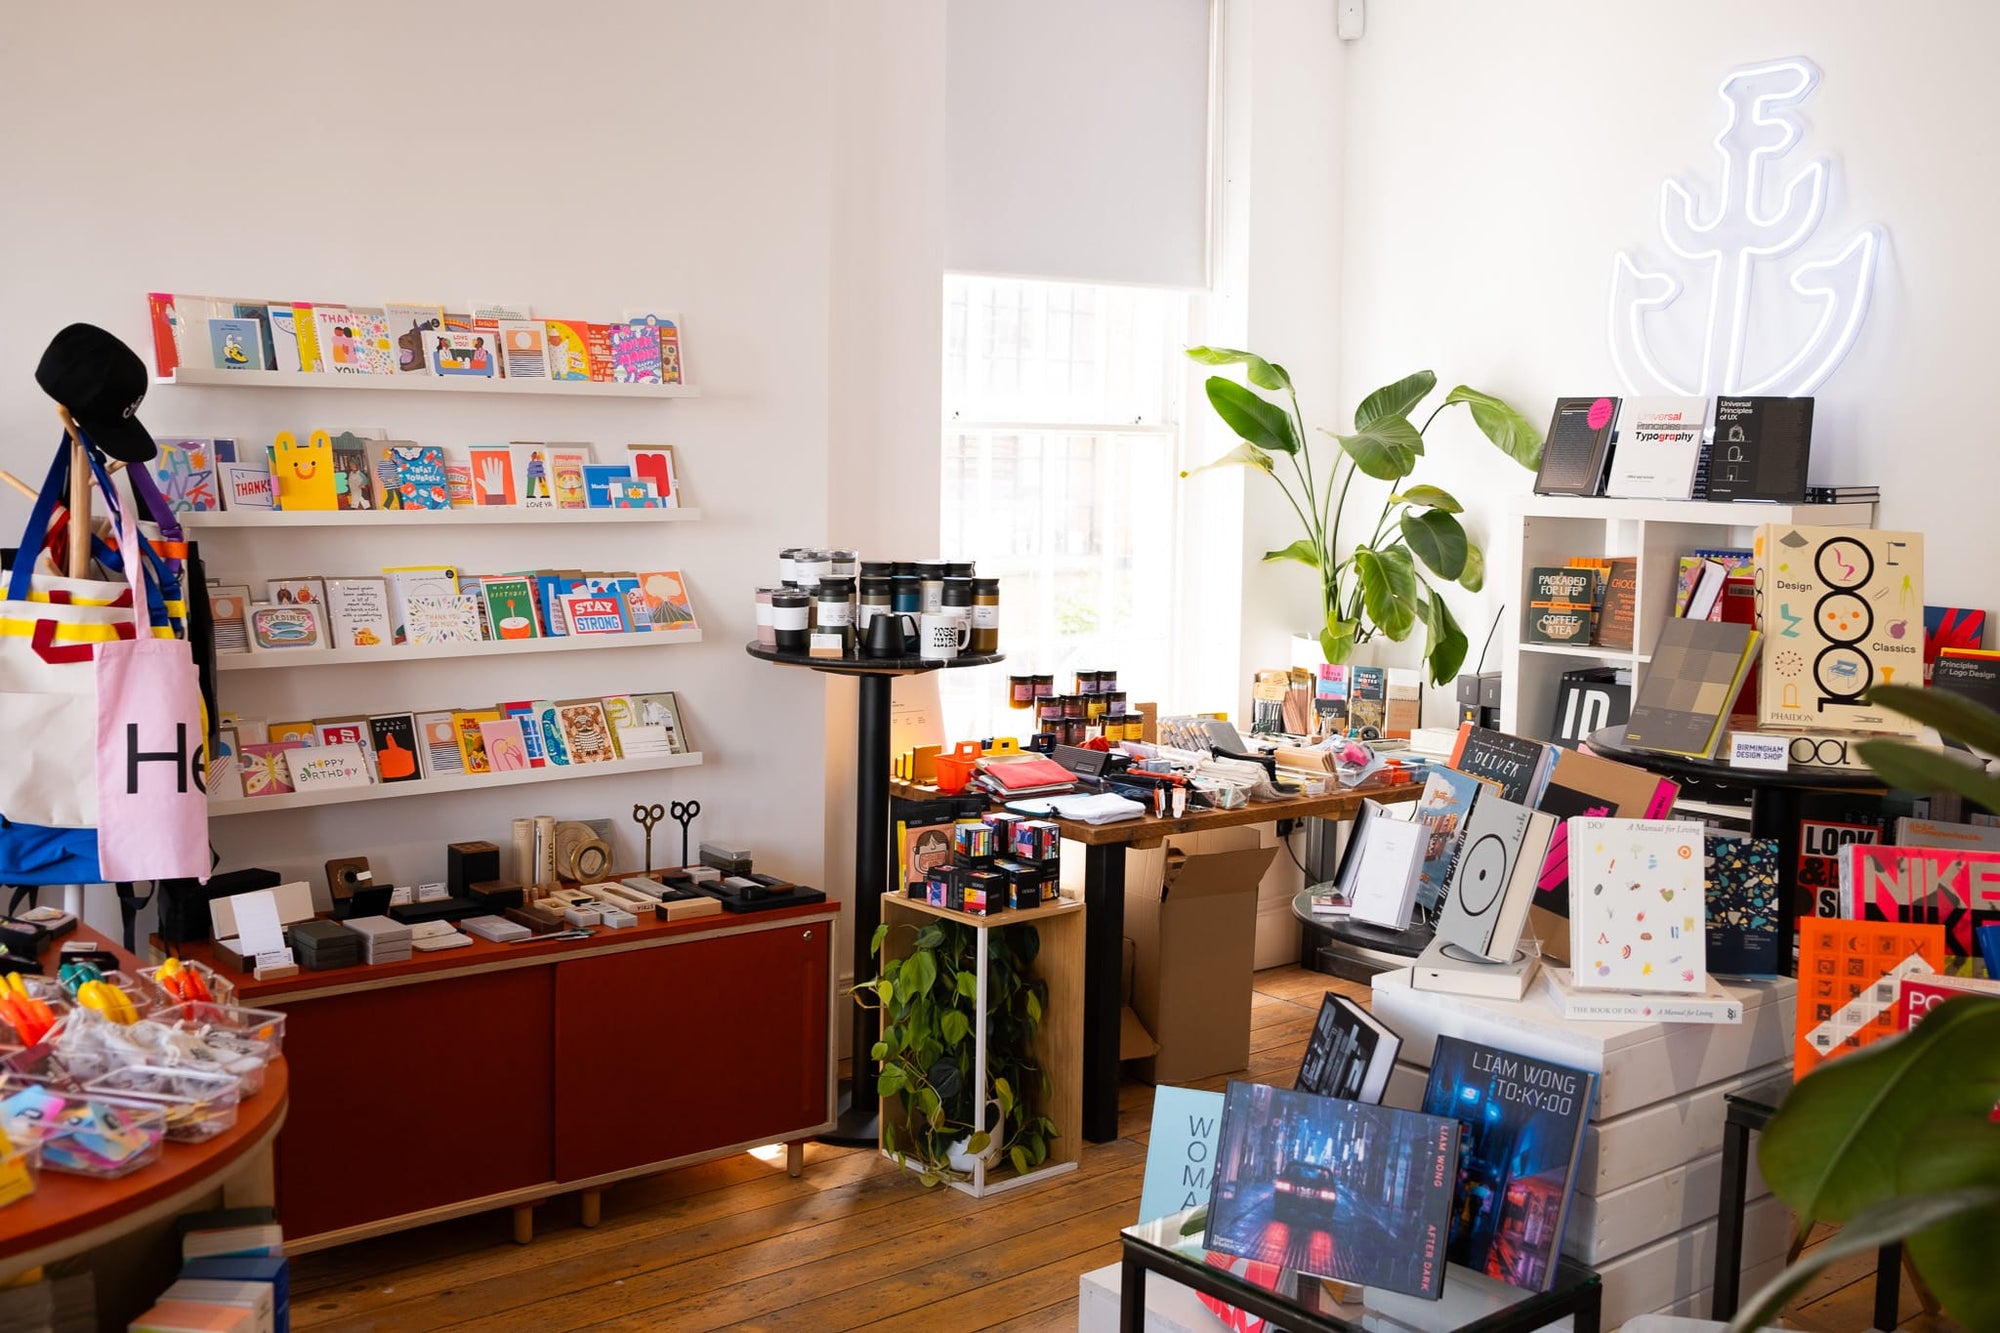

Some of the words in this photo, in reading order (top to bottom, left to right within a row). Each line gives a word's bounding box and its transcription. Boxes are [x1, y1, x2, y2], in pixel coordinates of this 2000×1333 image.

[1636, 432, 1694, 443] Typography
[1539, 576, 1587, 587] PACKAGED
[1776, 580, 1813, 592] Design
[1541, 586, 1559, 595] FOR
[574, 601, 613, 615] STAY
[264, 614, 307, 625] SARDINES
[577, 616, 619, 631] STRONG
[1542, 615, 1578, 625] COFFEE
[1554, 626, 1572, 635] TEA
[1872, 642, 1916, 654] Classics
[1941, 660, 1978, 670] Principles
[1949, 669, 1968, 678] Logo
[1968, 671, 1996, 680] Design
[1770, 711, 1814, 722] PHAIDON
[1736, 743, 1784, 753] BIRMINGHAM
[1736, 750, 1763, 760] DESIGN
[1763, 752, 1783, 761] SHOP
[1474, 751, 1520, 778] OLIVER
[1635, 824, 1664, 832] Manual
[1664, 826, 1676, 834] for
[1676, 826, 1701, 836] Living
[1799, 856, 1826, 886] &
[1864, 854, 2000, 913] NIKE
[1695, 1010, 1713, 1018] Living
[1472, 1051, 1519, 1079] LIAM
[1523, 1064, 1577, 1095] WONG
[1438, 1125, 1449, 1152] LIAM
[1433, 1154, 1446, 1189] WONG
[1424, 1224, 1438, 1260] AFTER
[1420, 1262, 1433, 1292] DARK
